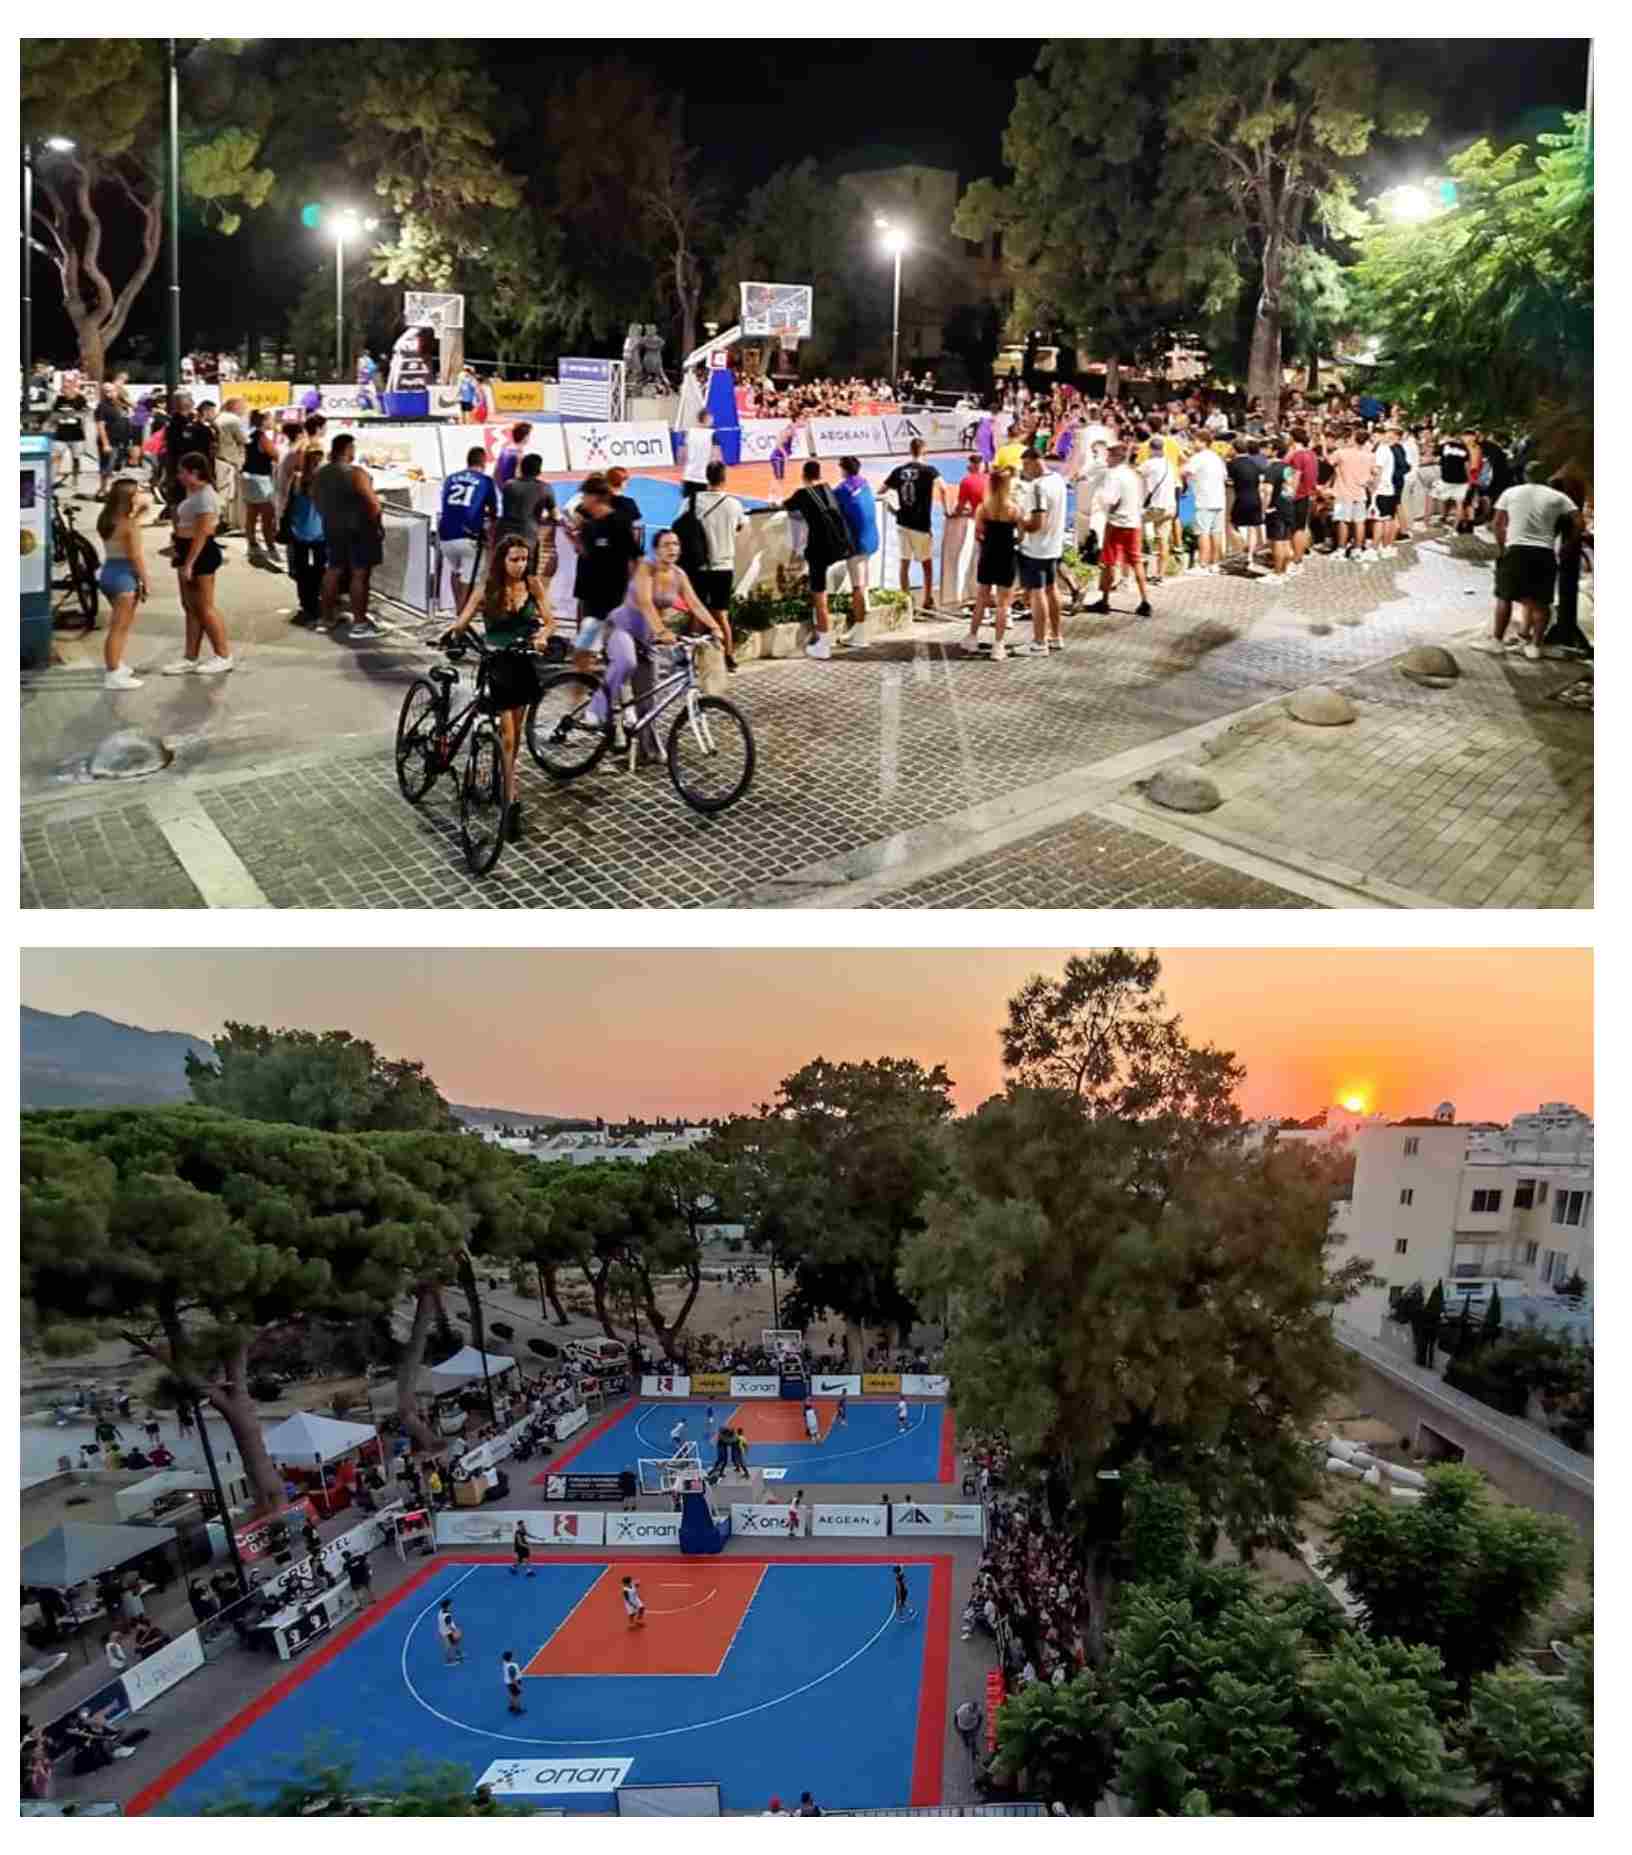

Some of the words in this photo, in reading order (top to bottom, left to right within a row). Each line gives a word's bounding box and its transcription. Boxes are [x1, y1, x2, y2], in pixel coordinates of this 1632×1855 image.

[819, 430, 869, 442] AEGEAN
[448, 484, 475, 507] 21
[818, 1515, 870, 1525] AEGEAN
